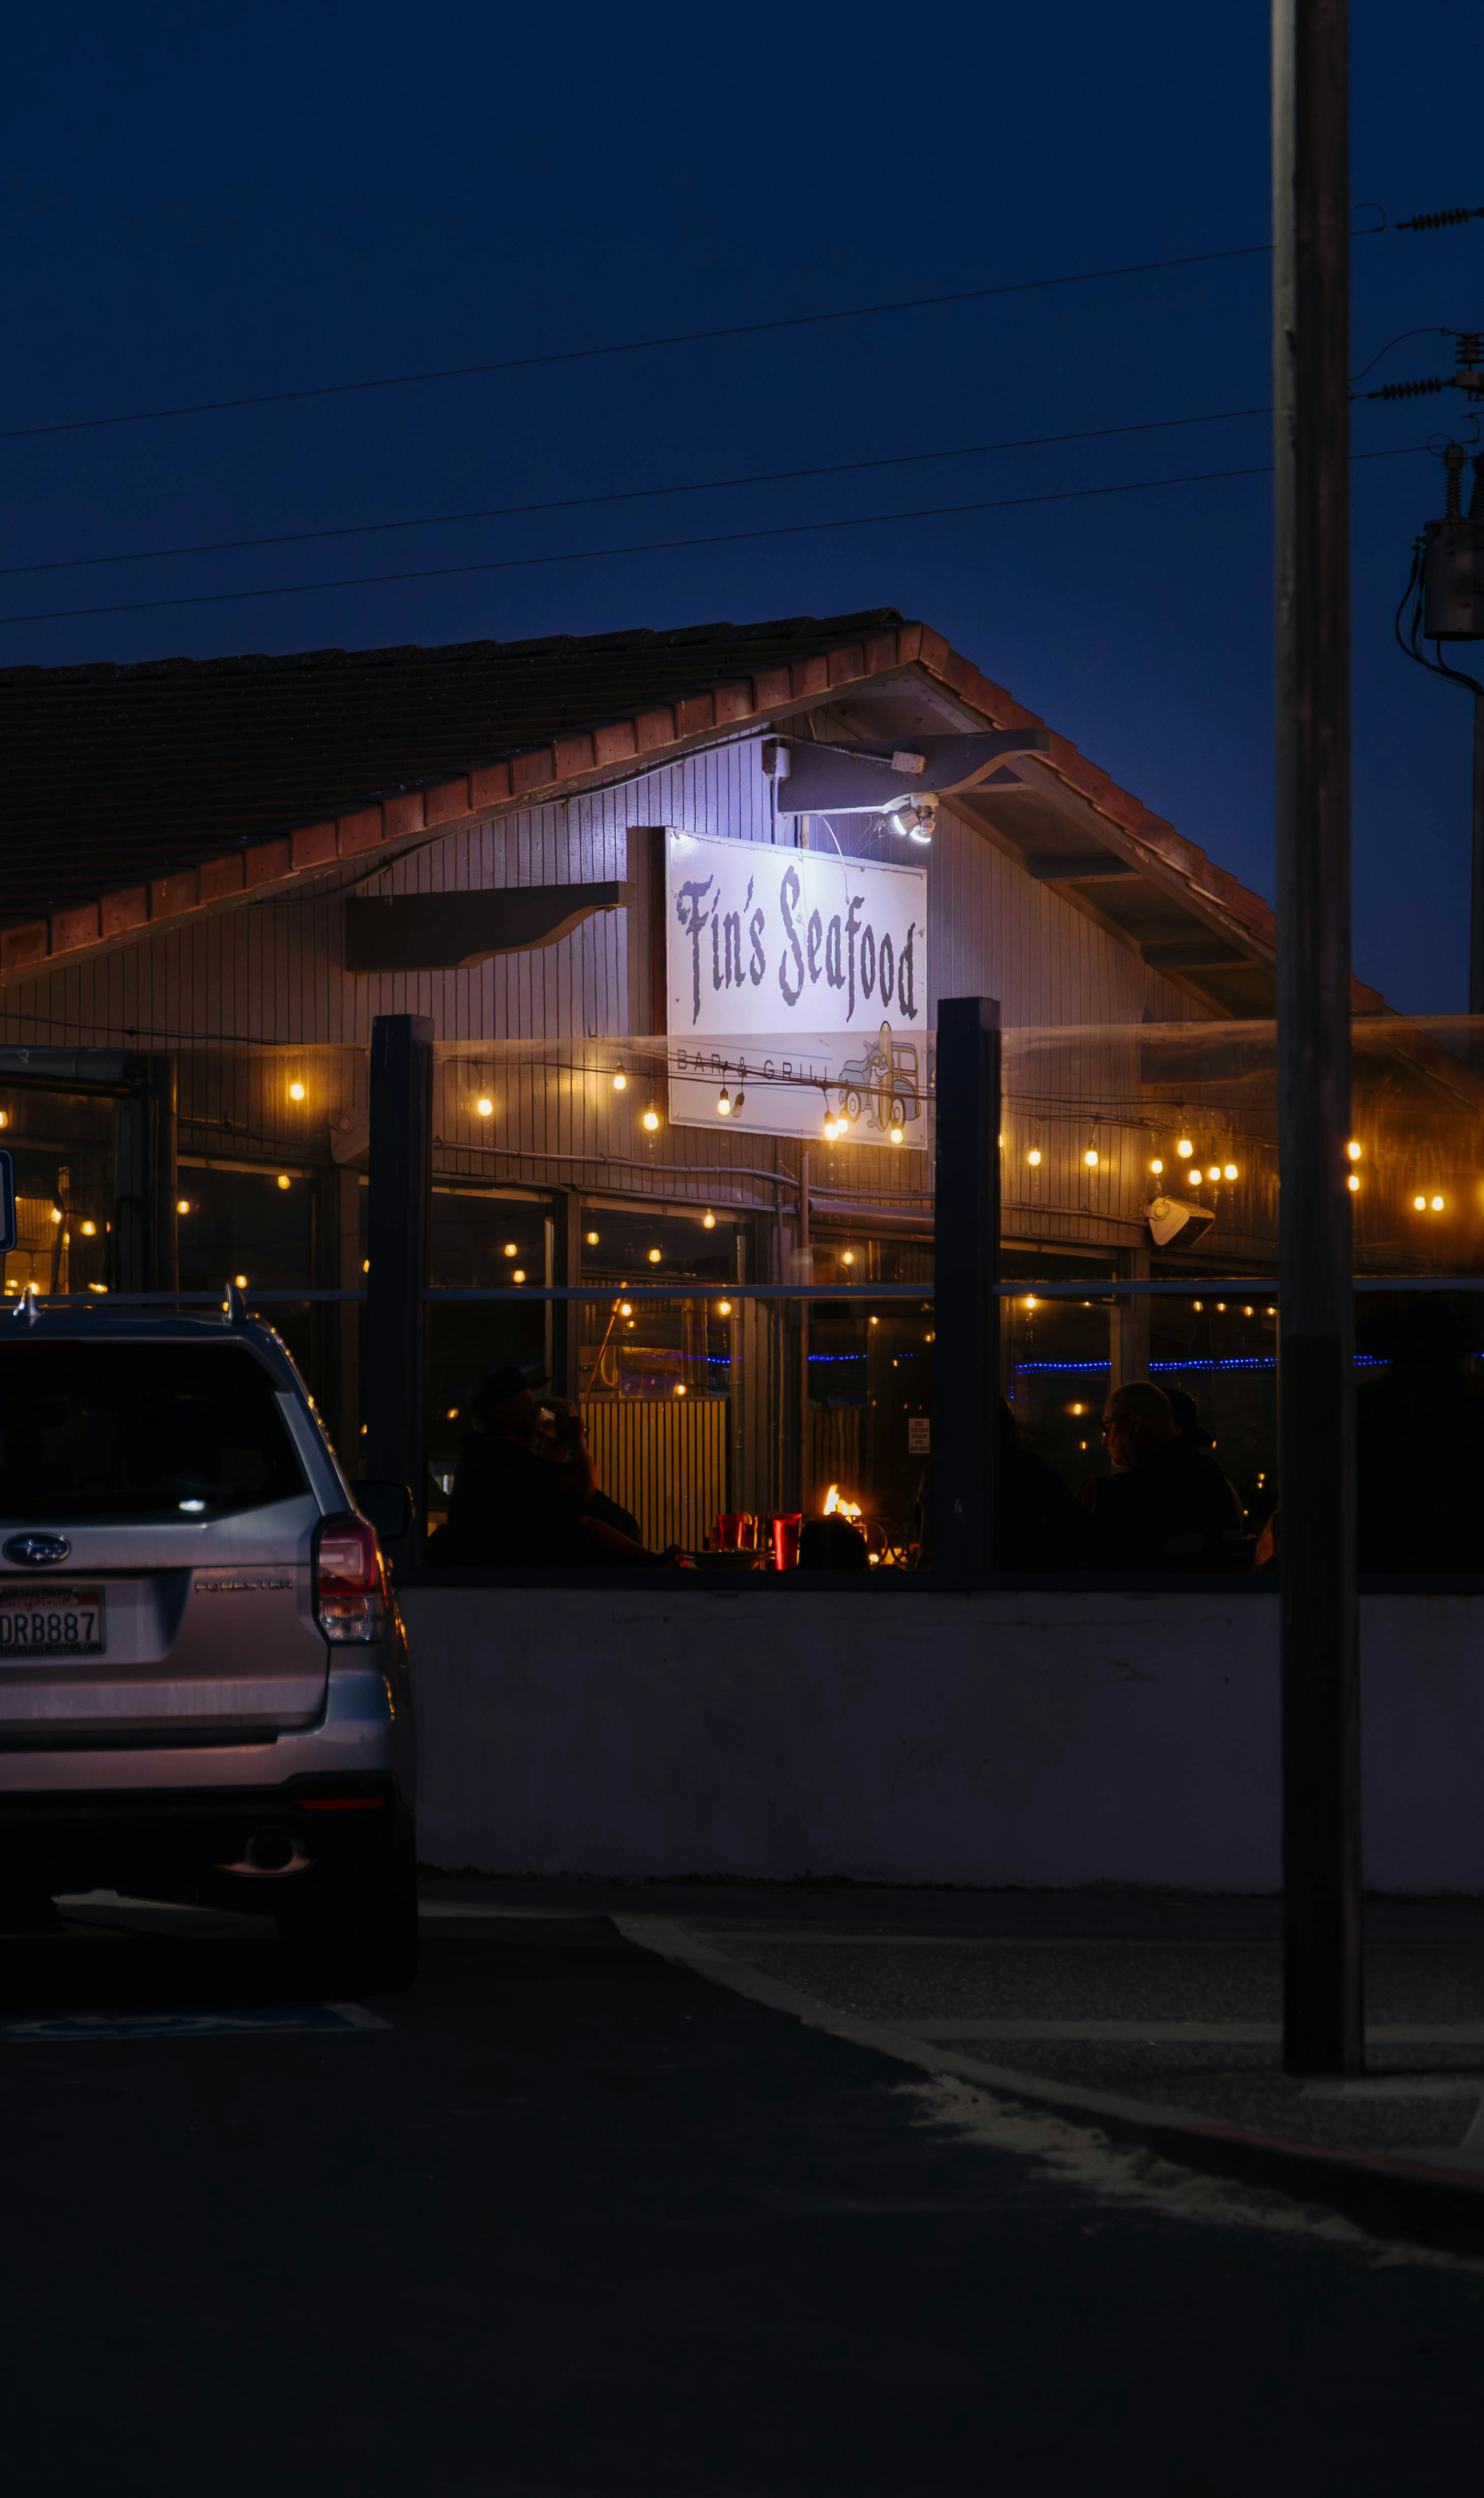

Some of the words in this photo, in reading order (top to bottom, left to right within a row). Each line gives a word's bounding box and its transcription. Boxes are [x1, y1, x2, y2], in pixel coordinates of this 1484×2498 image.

[677, 874, 765, 1025] Fin's
[779, 865, 917, 1023] Seafood
[677, 1049, 721, 1075] BAR
[737, 1056, 747, 1077] &
[764, 1059, 832, 1085] GRILL
[195, 1580, 293, 1593] FORESTER
[0, 1612, 95, 1643] DRB887
